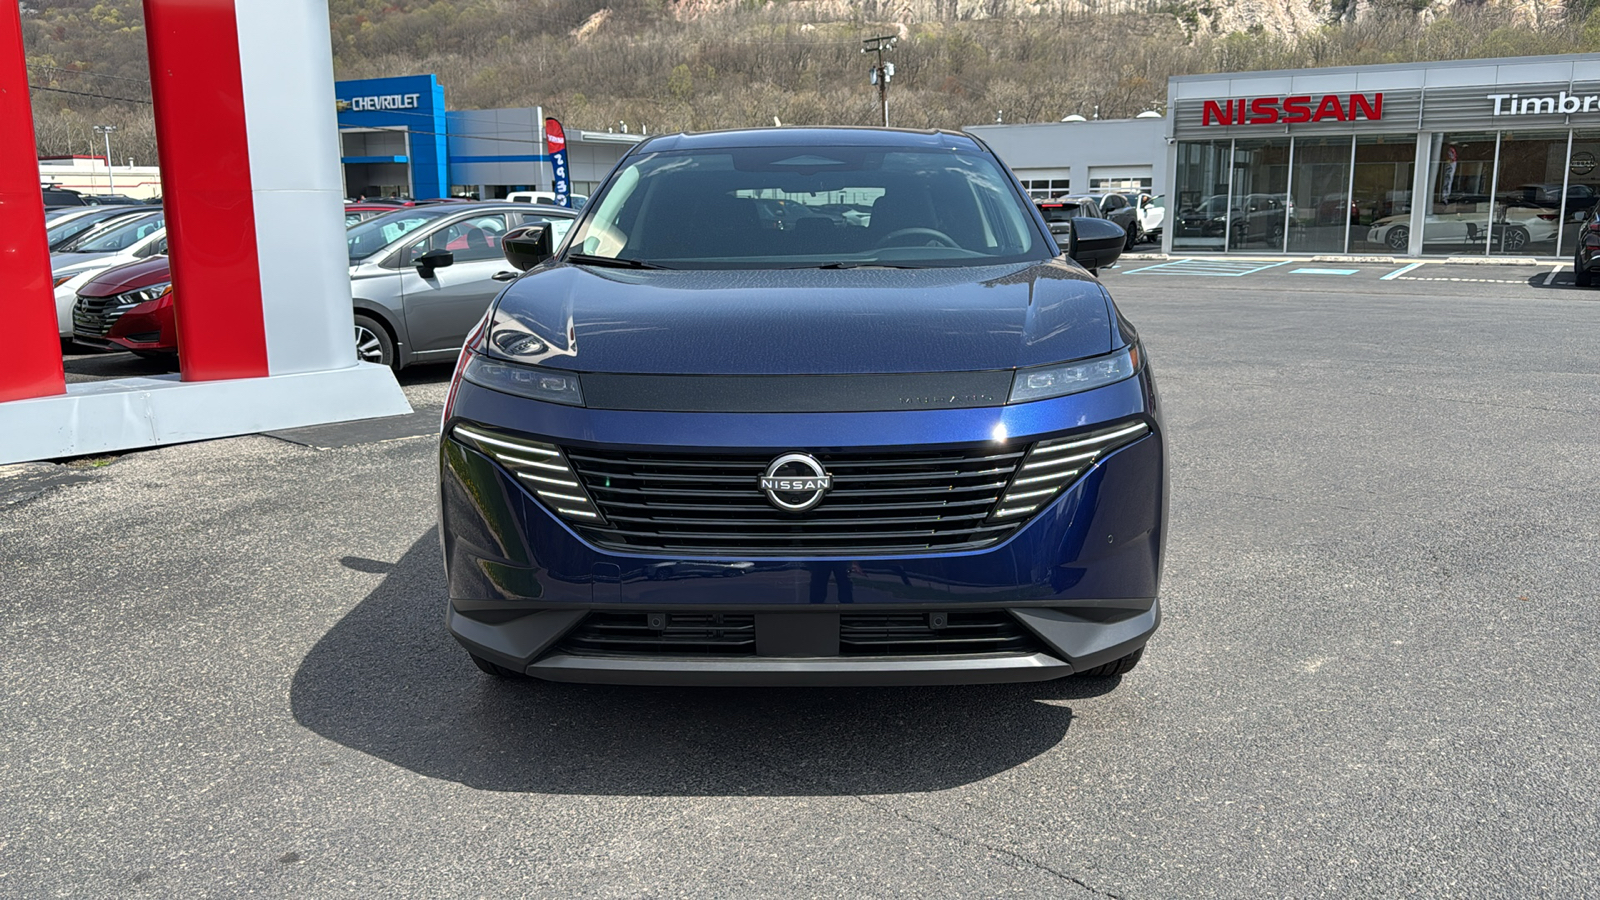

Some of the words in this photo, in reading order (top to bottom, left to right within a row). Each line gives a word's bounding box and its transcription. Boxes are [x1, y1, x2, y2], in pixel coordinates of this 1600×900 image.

[352, 93, 420, 111] CHEVROLET
[1202, 92, 1383, 126] NISSAN
[1487, 91, 1600, 116] Timbr
[762, 479, 828, 490] NISSAN
